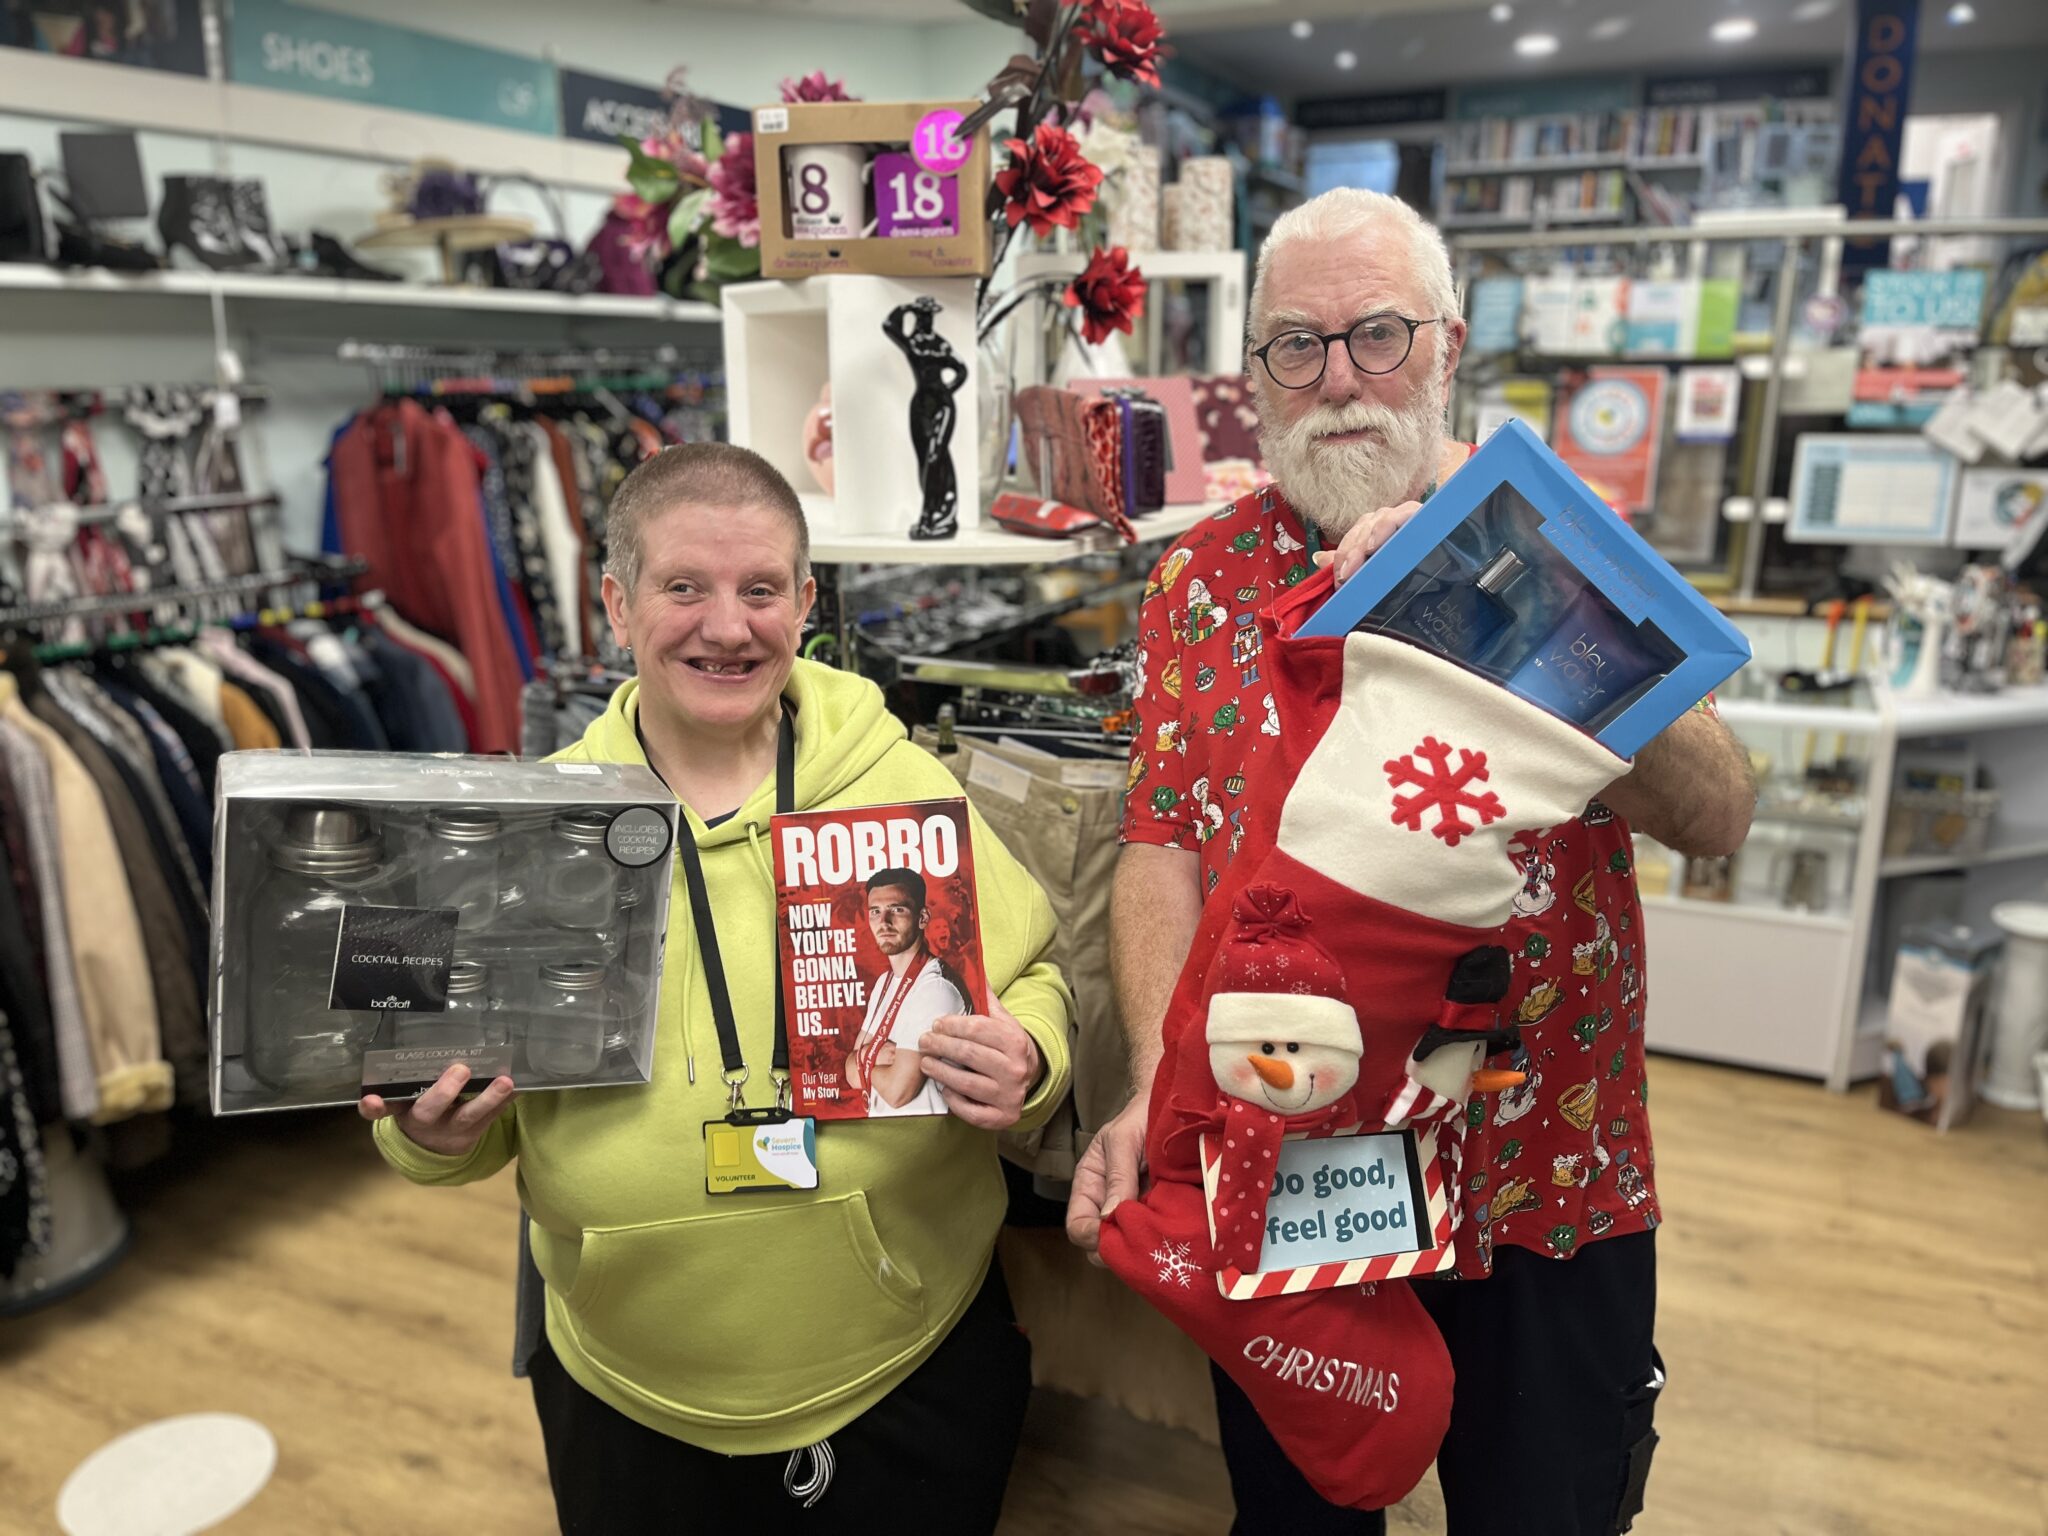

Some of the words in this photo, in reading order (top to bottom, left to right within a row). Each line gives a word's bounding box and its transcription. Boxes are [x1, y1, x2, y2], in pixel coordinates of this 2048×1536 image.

[261, 32, 374, 88] SHOES
[889, 171, 944, 221] 18
[1437, 596, 1472, 633] bleu
[1569, 632, 1615, 680] bleu
[614, 824, 659, 834] INCLUDES
[659, 825, 666, 834] 6
[617, 835, 659, 845] COCKTAIL
[618, 846, 656, 855] RECIPES
[781, 814, 959, 888] ROBBO
[788, 903, 832, 930] NOW
[790, 928, 857, 956] YOU'RE
[351, 954, 400, 965] COCKTAIL
[402, 956, 444, 966] RECIPES
[793, 955, 858, 983] GONNA
[370, 998, 412, 1009] barcraft
[794, 981, 867, 1010] BELIEVE
[796, 1011, 840, 1037] US...
[394, 1052, 425, 1060] GLASS
[426, 1050, 468, 1058] COCKTAIL
[470, 1048, 483, 1056] KIT
[801, 1072, 816, 1085] Our
[818, 1071, 838, 1084] Year
[803, 1087, 816, 1100] My
[817, 1086, 840, 1100] Story
[771, 1143, 802, 1152] Hospice
[715, 1174, 756, 1182] VOLUNTEER
[1313, 1158, 1395, 1199] good,
[1266, 1209, 1327, 1245] feel
[1334, 1201, 1408, 1242] good
[1242, 1335, 1401, 1414] CHRISTMAS
